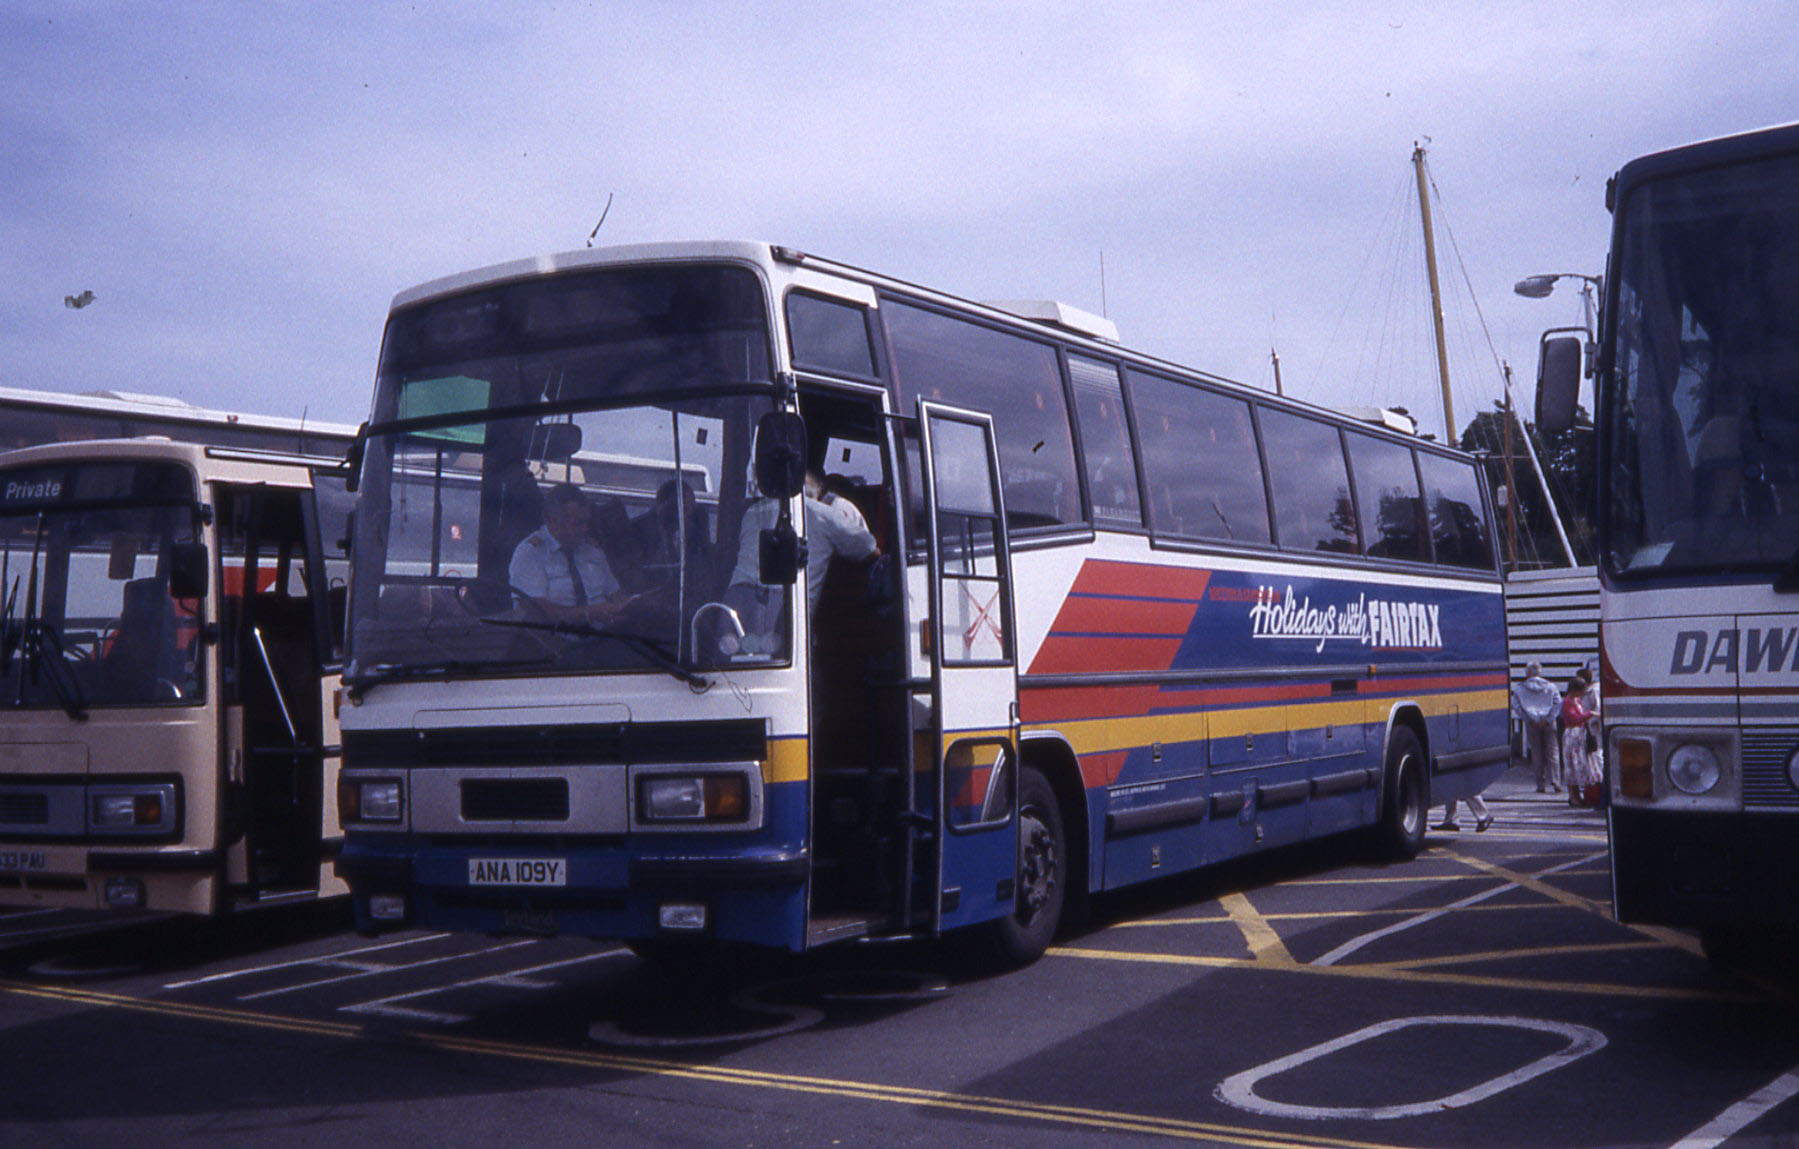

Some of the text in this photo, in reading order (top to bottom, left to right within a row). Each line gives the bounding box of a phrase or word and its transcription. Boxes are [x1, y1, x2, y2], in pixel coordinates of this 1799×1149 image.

[6, 480, 61, 499] Private
[1249, 584, 1443, 653] Holidays with FAIRTAX
[476, 861, 560, 883] ANA 109Y
